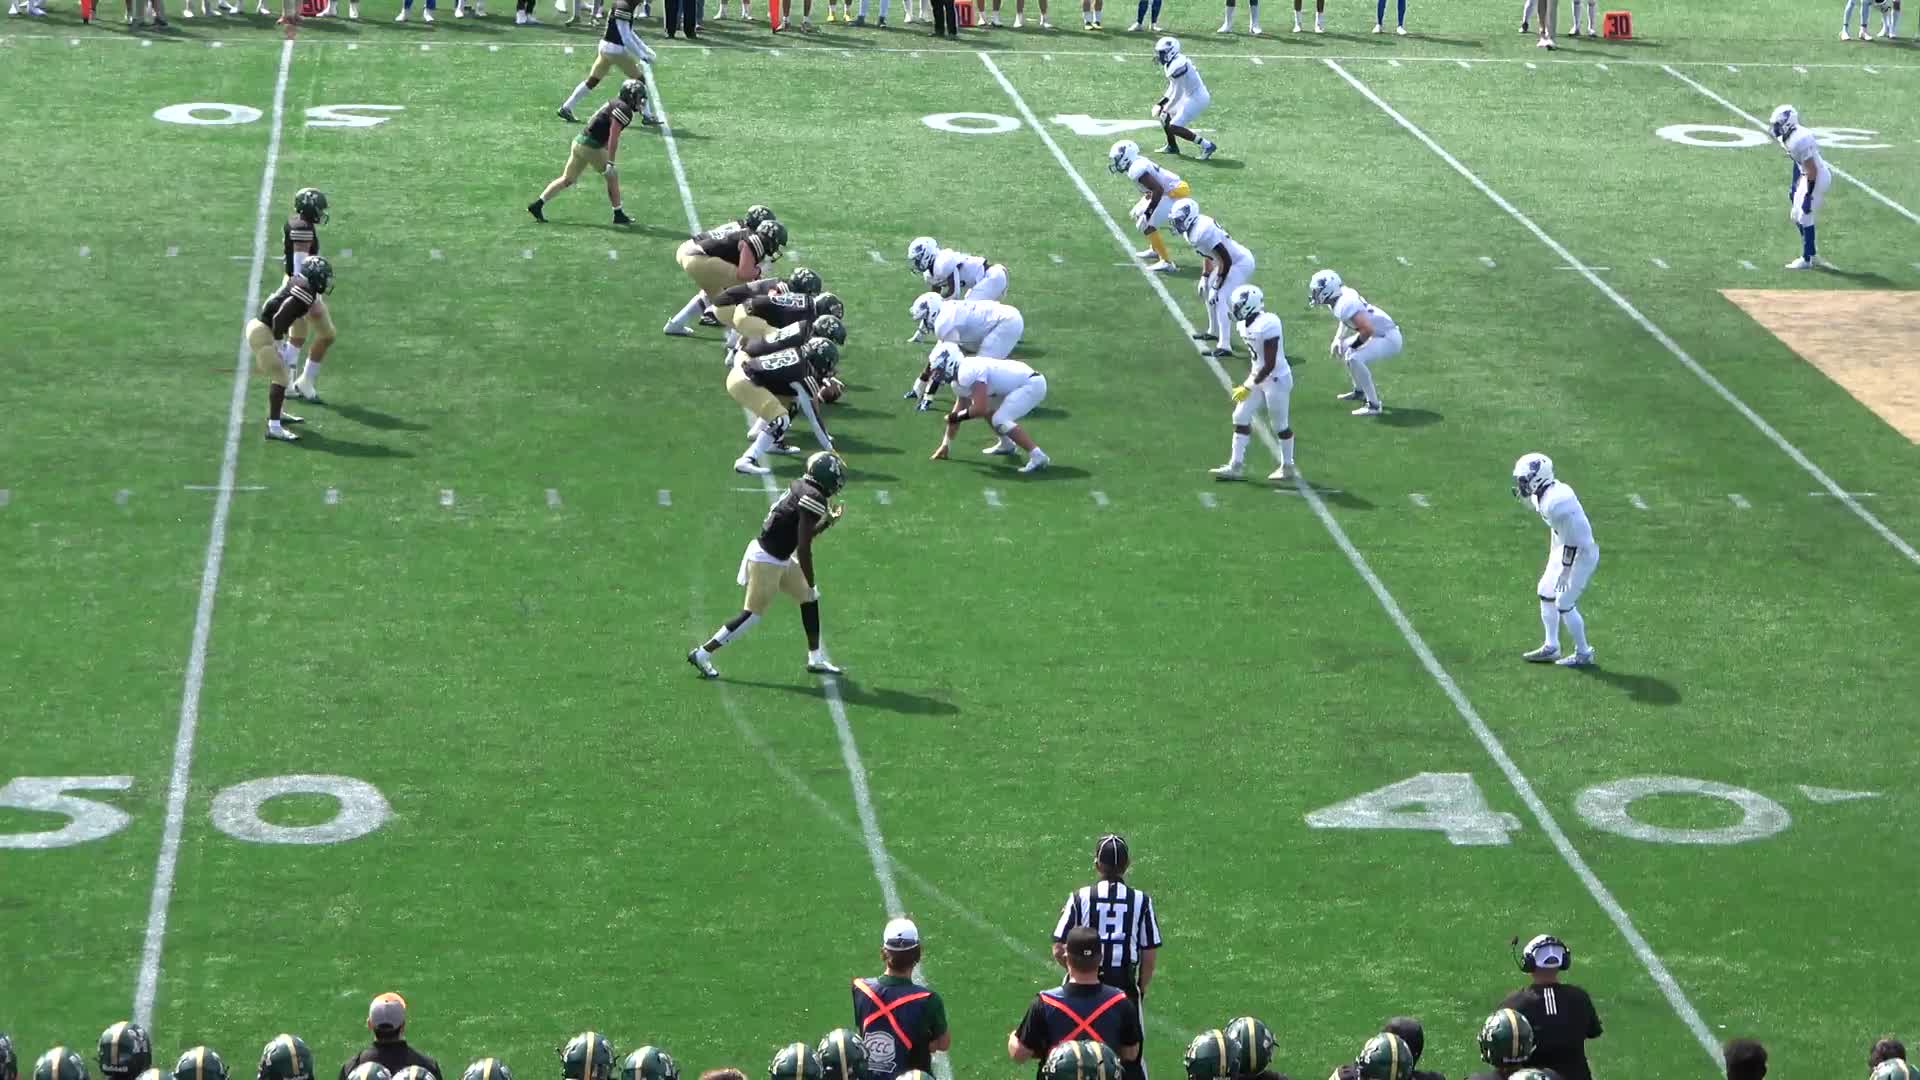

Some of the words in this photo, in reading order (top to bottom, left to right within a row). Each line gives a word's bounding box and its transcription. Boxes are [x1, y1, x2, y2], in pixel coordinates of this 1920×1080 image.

[1607, 15, 1630, 35] 30
[0, 774, 390, 848] 50
[1304, 772, 1791, 845] 40
[1096, 902, 1128, 940] H
